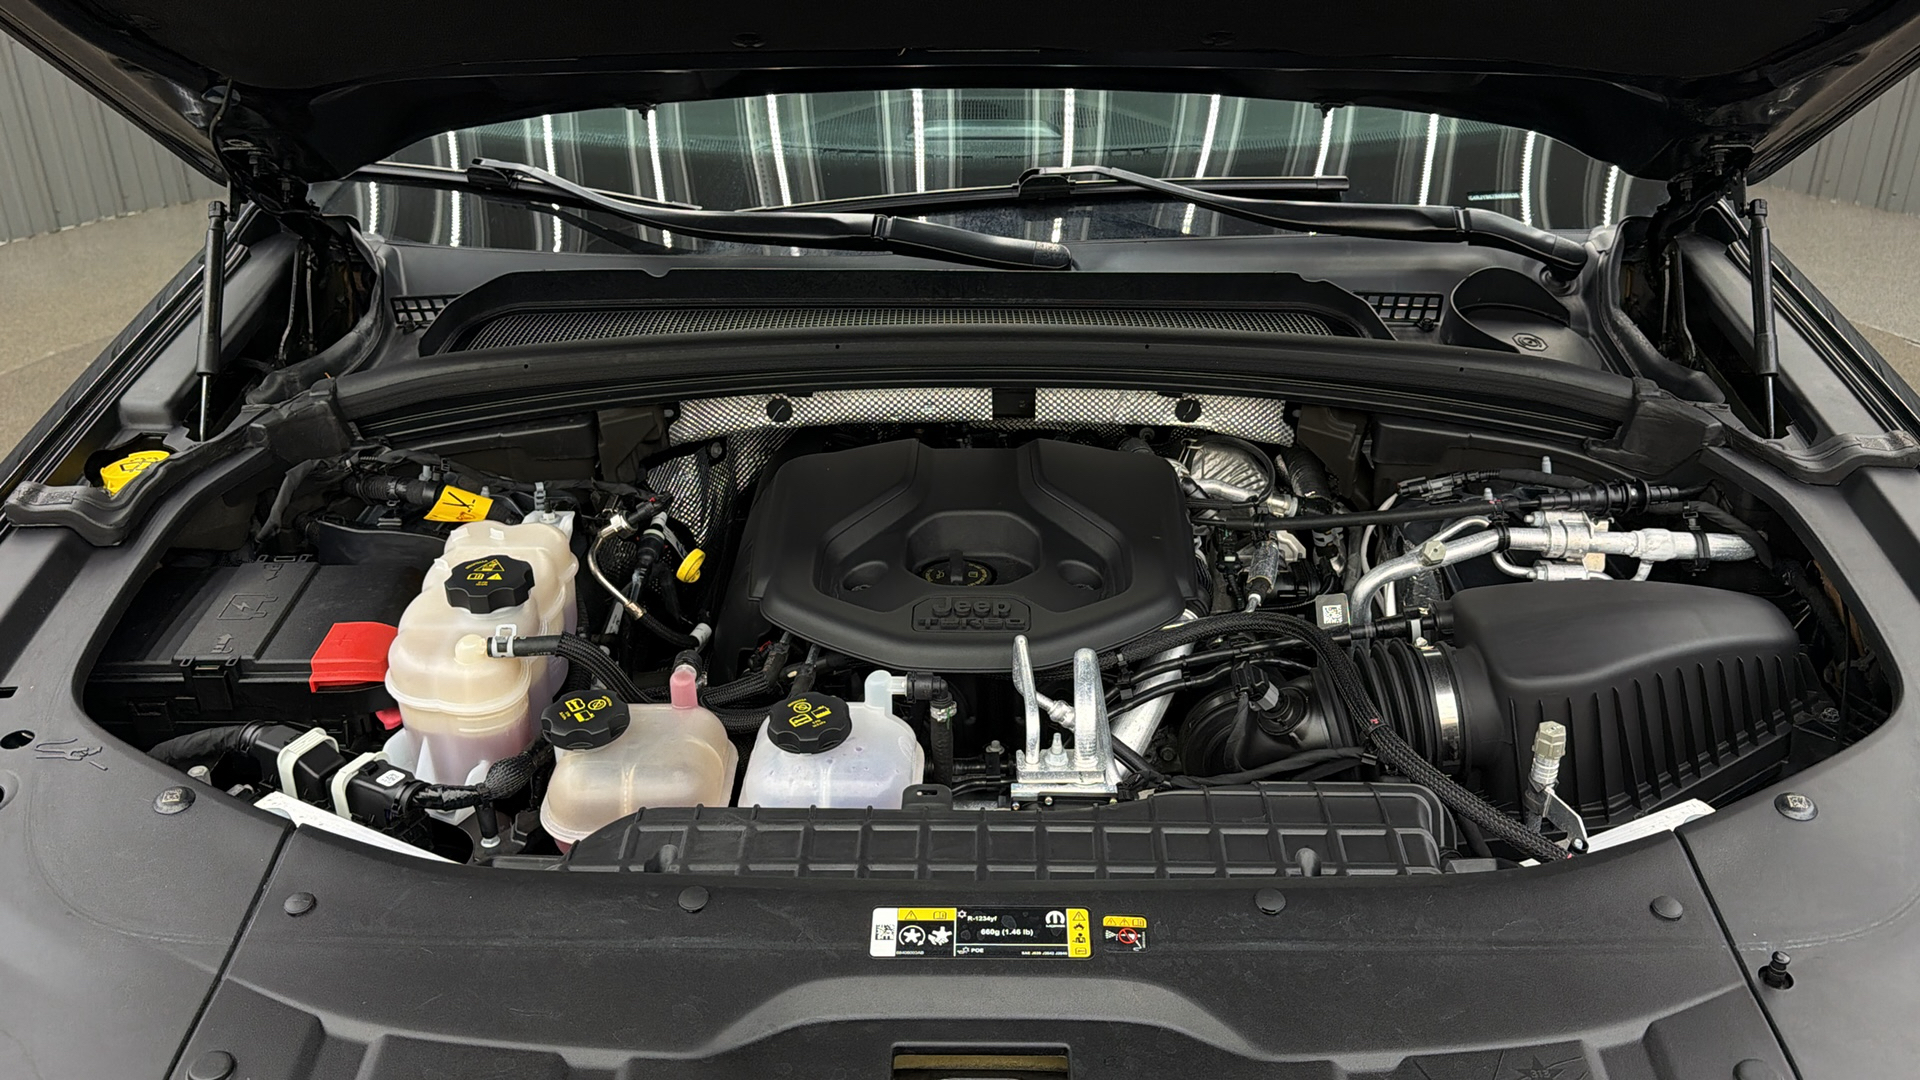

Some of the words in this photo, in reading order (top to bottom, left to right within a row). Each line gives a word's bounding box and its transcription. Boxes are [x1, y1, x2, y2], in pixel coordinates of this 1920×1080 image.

[932, 597, 1011, 618] Jeep
[967, 915, 998, 923] R-1234yf
[1023, 928, 1034, 937] lb)
